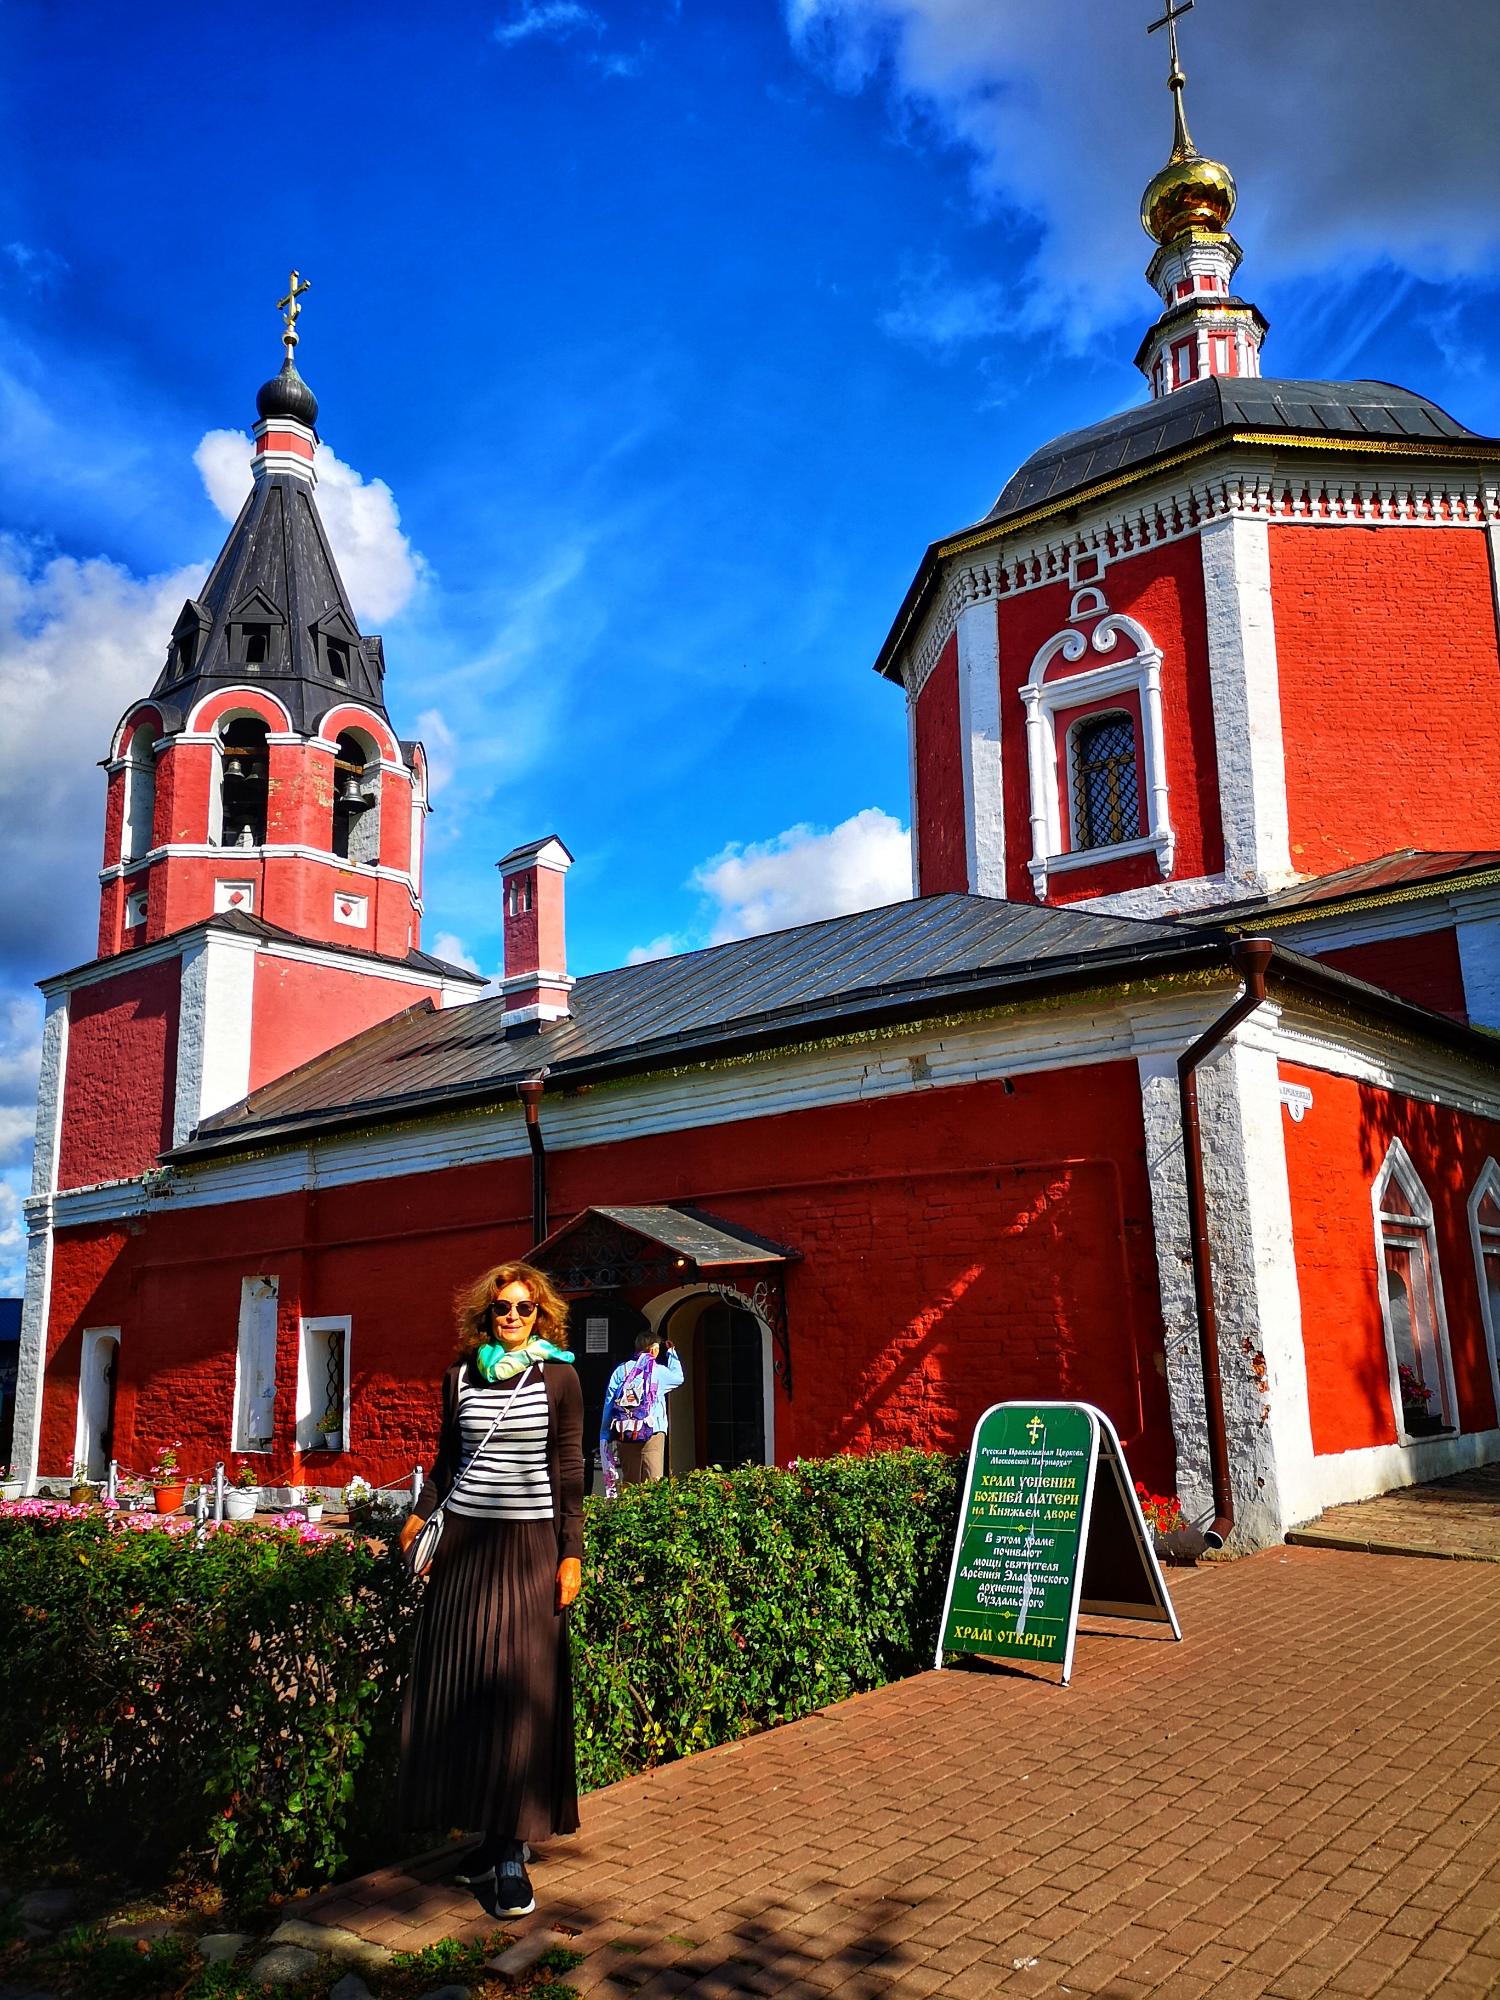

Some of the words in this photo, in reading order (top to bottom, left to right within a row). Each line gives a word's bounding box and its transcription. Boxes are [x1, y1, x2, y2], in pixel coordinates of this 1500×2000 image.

[1056, 1448, 1084, 1457] Церковь
[981, 1475, 1015, 1487] ХРАМ
[1019, 1476, 1076, 1490] УСПЕНИЯ
[974, 1491, 1023, 1504] БОЖИЕЙ
[1025, 1493, 1079, 1505] МАТЕРИ
[972, 1506, 985, 1515] на
[988, 1504, 1041, 1518] Княжьем
[1043, 1510, 1077, 1522] дворе
[995, 1535, 1021, 1544] этом
[972, 1558, 1002, 1569] мощи
[953, 1625, 993, 1642] ХРАМ
[997, 1630, 1057, 1648] ОТКРЫТ
